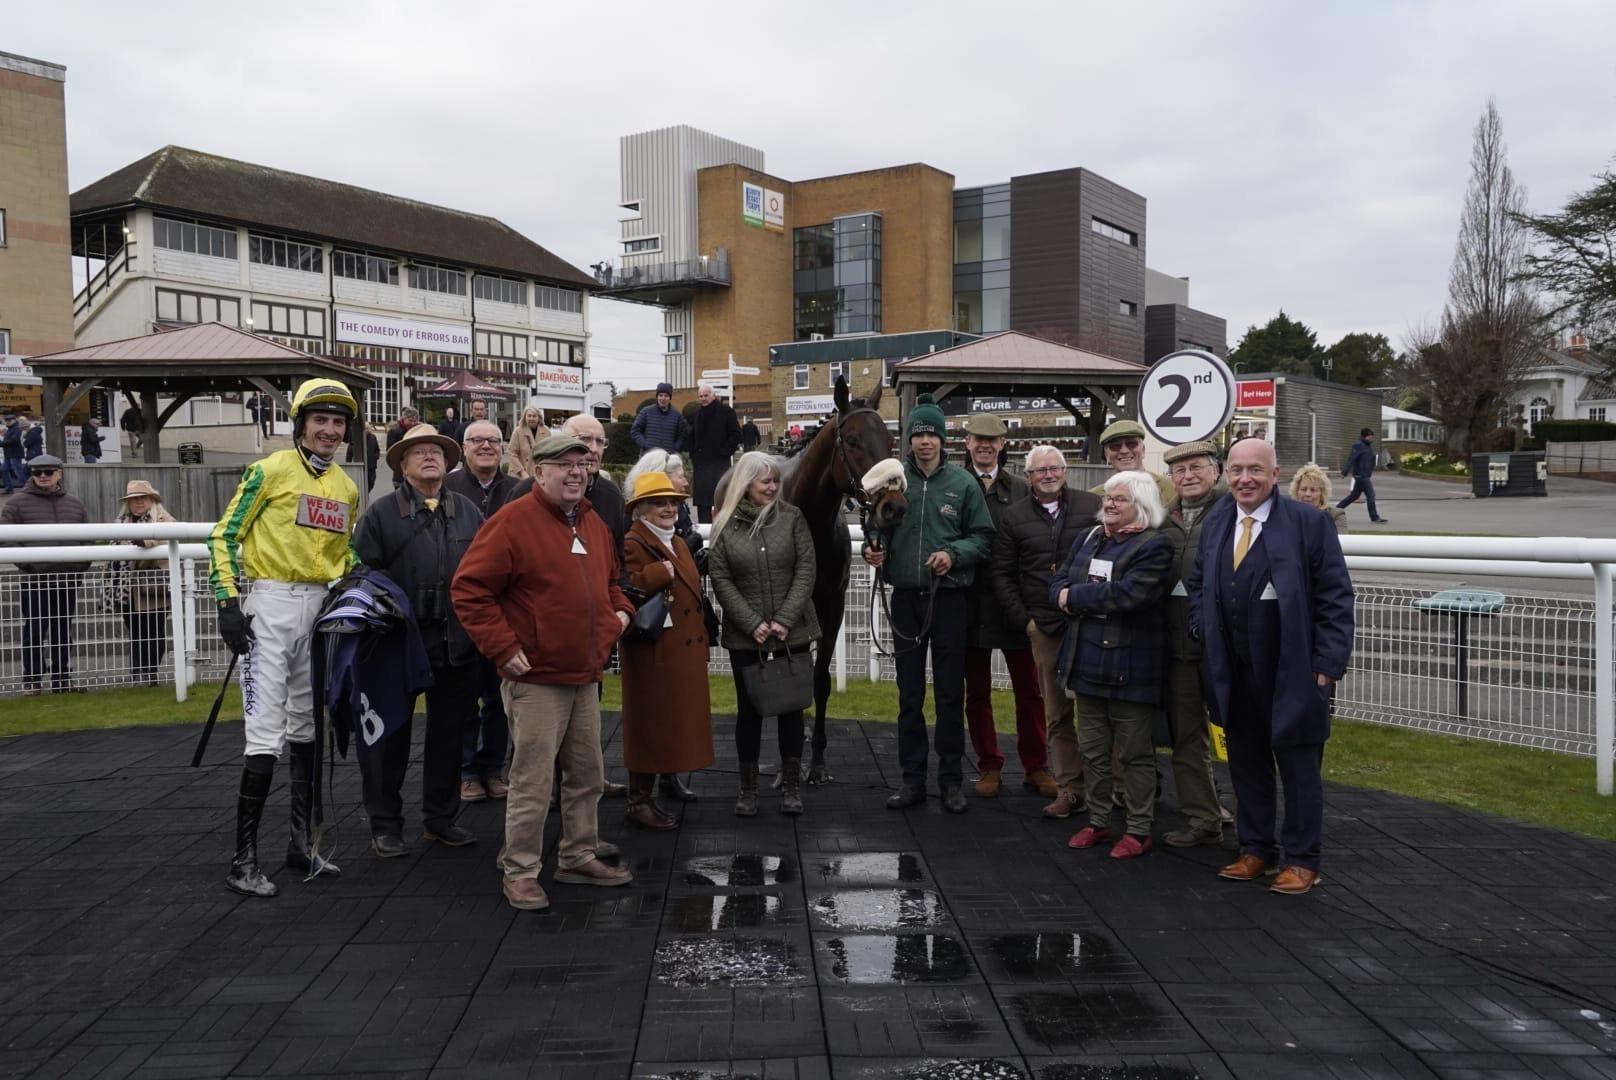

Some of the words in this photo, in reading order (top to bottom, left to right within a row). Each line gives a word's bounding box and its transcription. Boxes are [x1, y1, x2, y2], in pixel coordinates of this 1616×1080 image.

[340, 321, 359, 332] THE
[361, 324, 400, 337] COMEDY
[402, 329, 414, 339] OF
[416, 331, 450, 343] ERRORS
[452, 335, 470, 345] BAR
[539, 371, 581, 384] BAKEHOUSE
[1243, 391, 1255, 399] Bet
[972, 400, 1012, 411] FIGURE
[1031, 399, 1047, 409] OF
[306, 497, 323, 509] WE
[325, 501, 339, 512] DO
[360, 692, 385, 746] 8
